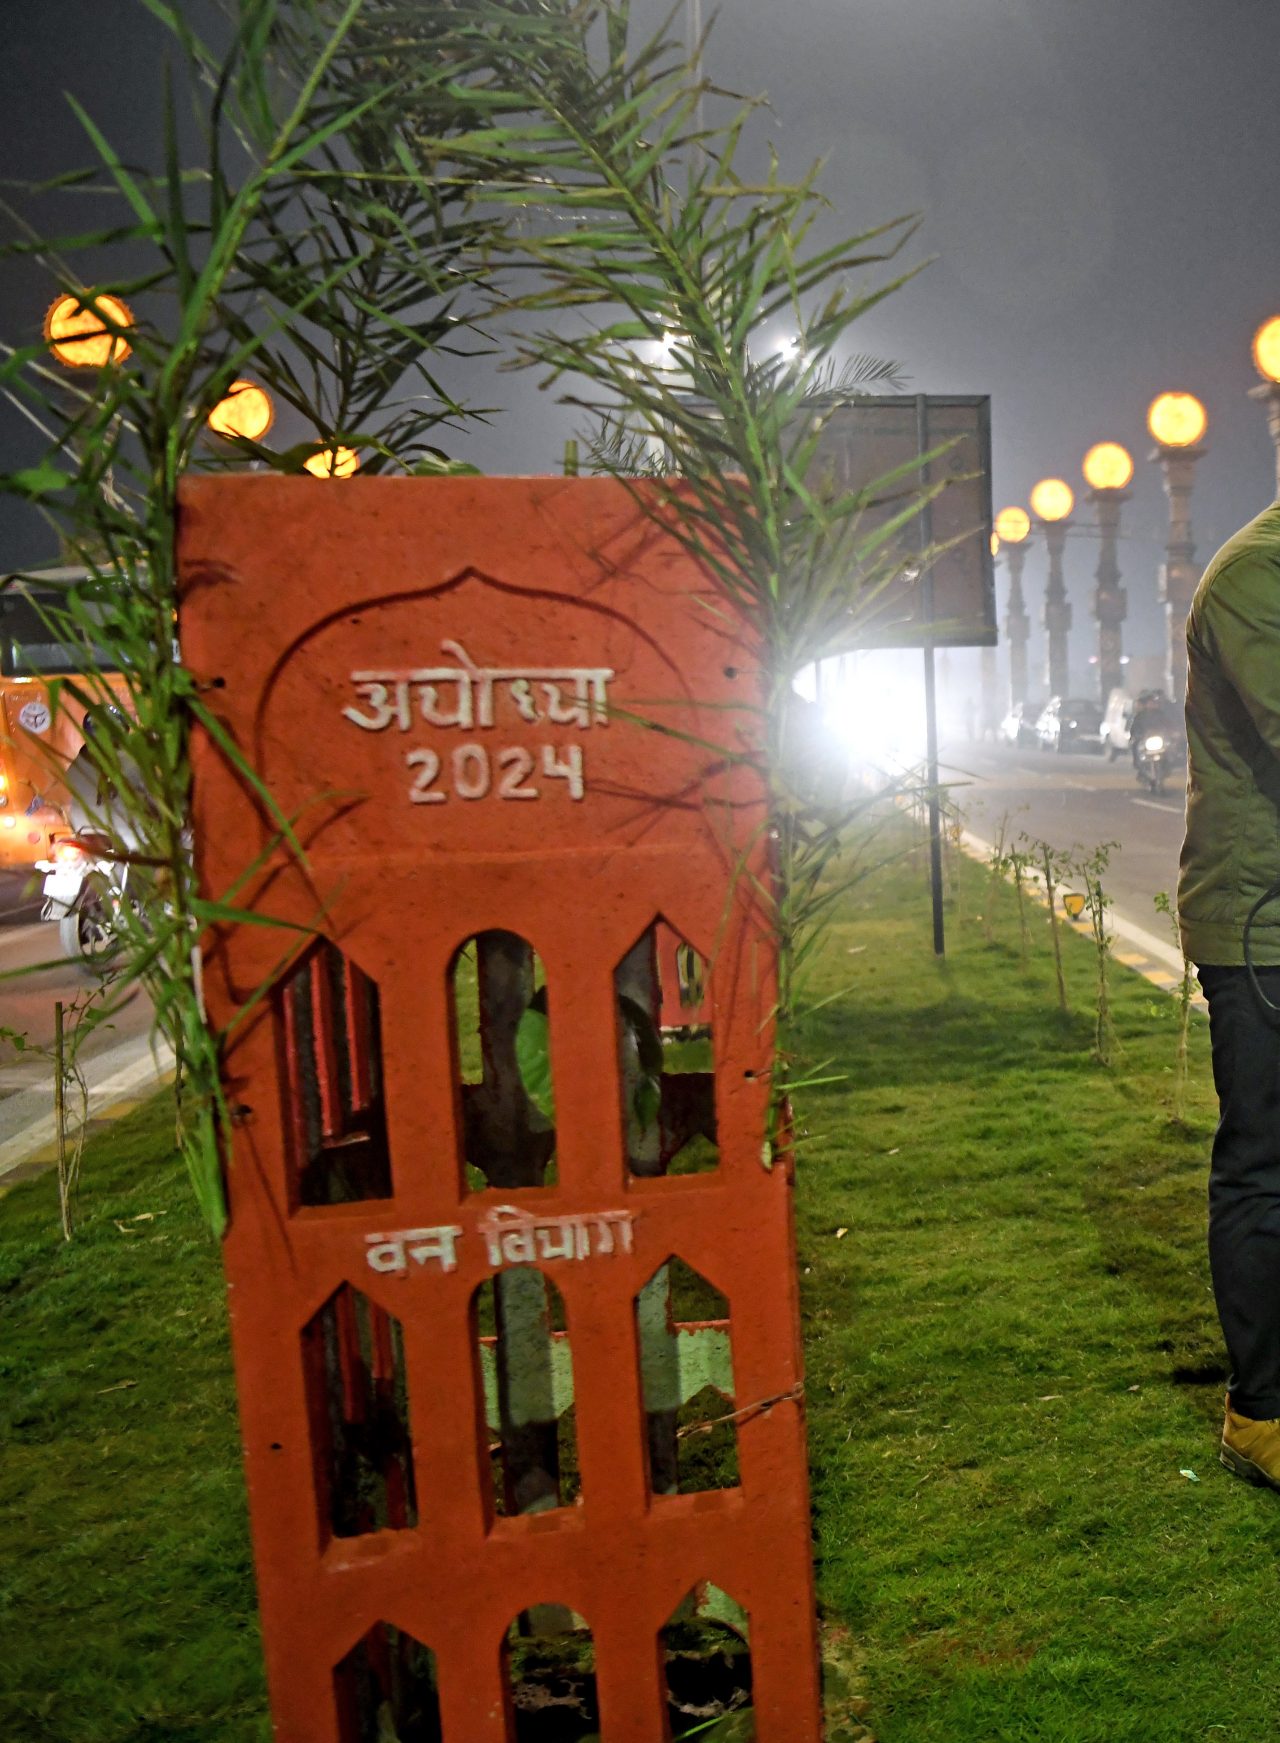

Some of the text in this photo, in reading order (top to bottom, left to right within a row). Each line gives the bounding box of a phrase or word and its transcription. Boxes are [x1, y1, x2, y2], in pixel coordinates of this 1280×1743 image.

[342, 639, 615, 731] अयोध्या
[406, 744, 585, 804] 2024
[364, 1225, 464, 1276] वन
